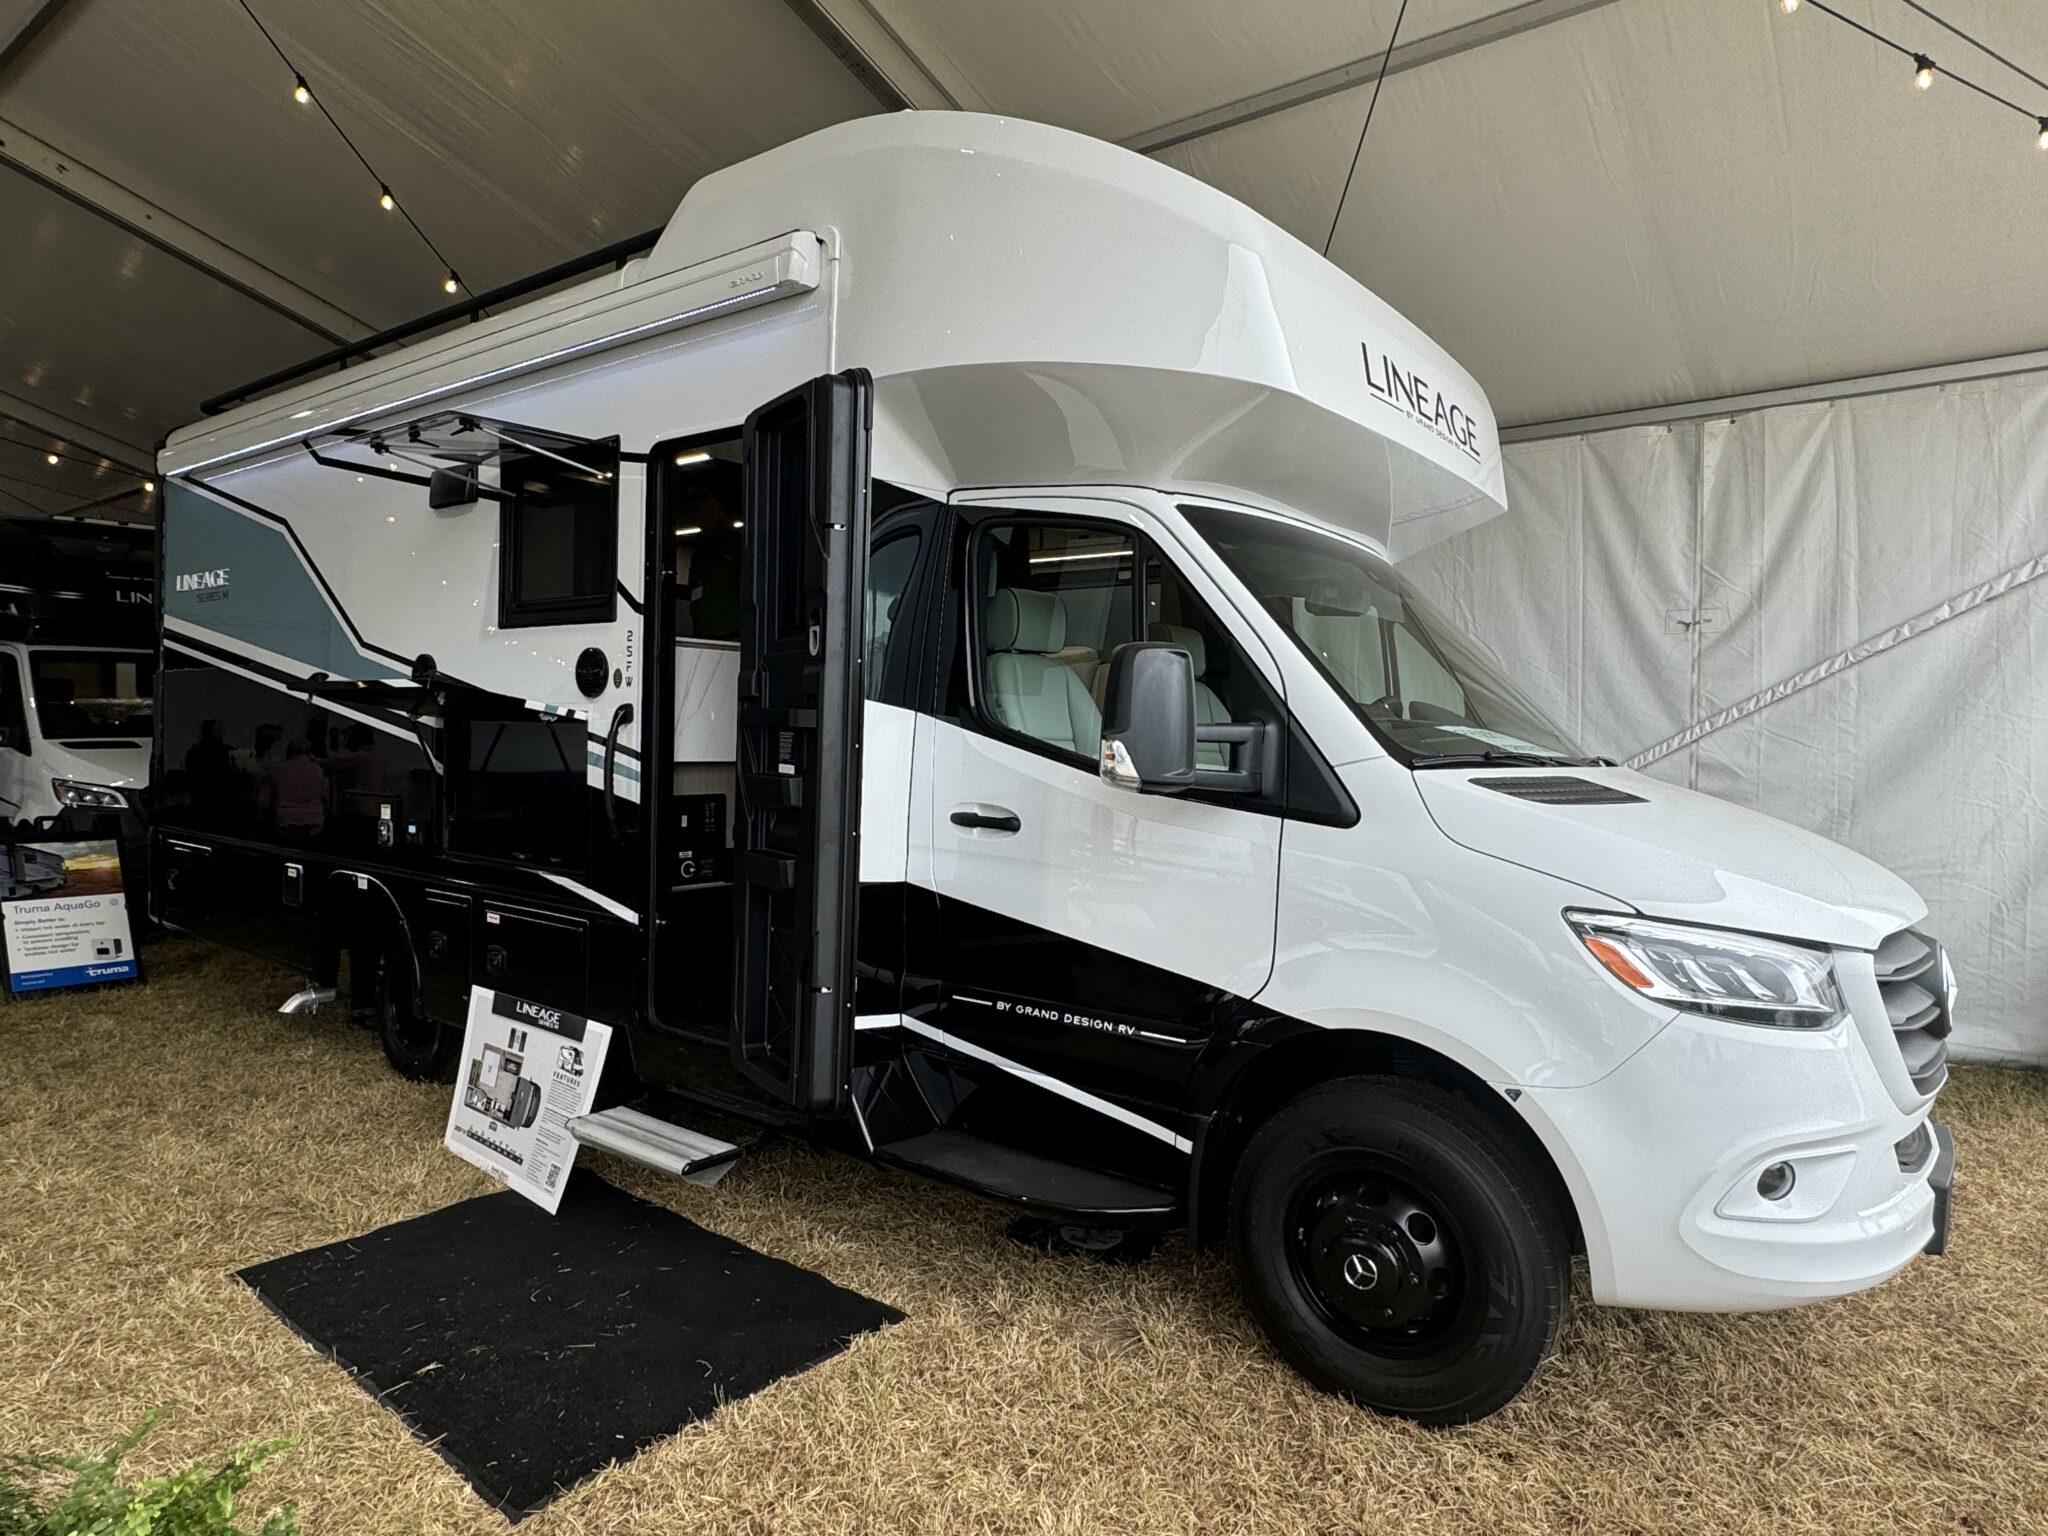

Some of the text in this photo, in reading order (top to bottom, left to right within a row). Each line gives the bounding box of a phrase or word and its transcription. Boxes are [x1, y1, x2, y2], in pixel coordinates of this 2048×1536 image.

[1361, 341, 1480, 457] LINEAGE
[176, 568, 230, 591] LINEAGE
[116, 590, 153, 604] LIN
[14, 900, 101, 914] Truma AquaGo
[86, 966, 129, 977] truma
[516, 1000, 561, 1025] LINEAGE
[996, 1001, 1136, 1036] BY GRAND DESIGN RV
[553, 1070, 581, 1088] FEATURES
